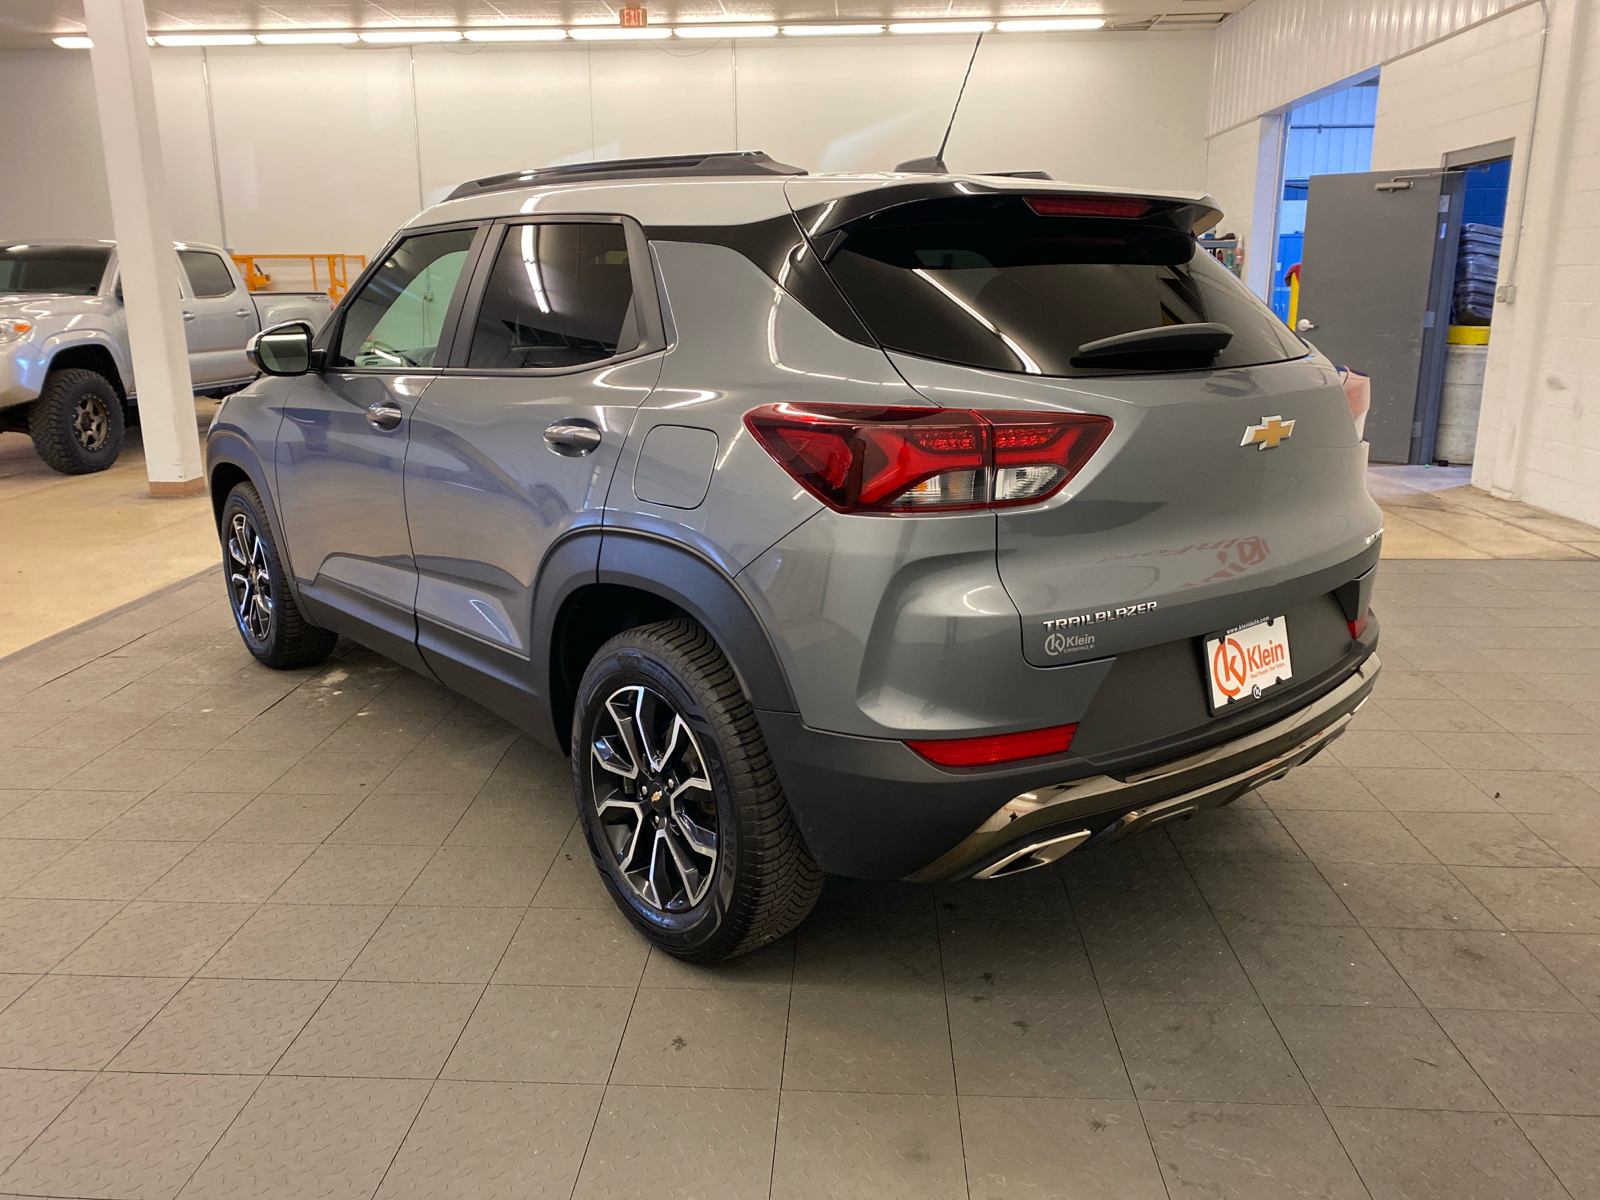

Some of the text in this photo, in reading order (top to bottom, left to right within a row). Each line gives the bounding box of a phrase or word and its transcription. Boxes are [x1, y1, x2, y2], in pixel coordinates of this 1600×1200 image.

[624, 9, 643, 26] EXIT
[1043, 601, 1158, 632] TRAILBLAZER
[1226, 616, 1270, 634] www.kleinauto.com
[1066, 634, 1095, 648] Klein
[1246, 640, 1284, 672] Klein
